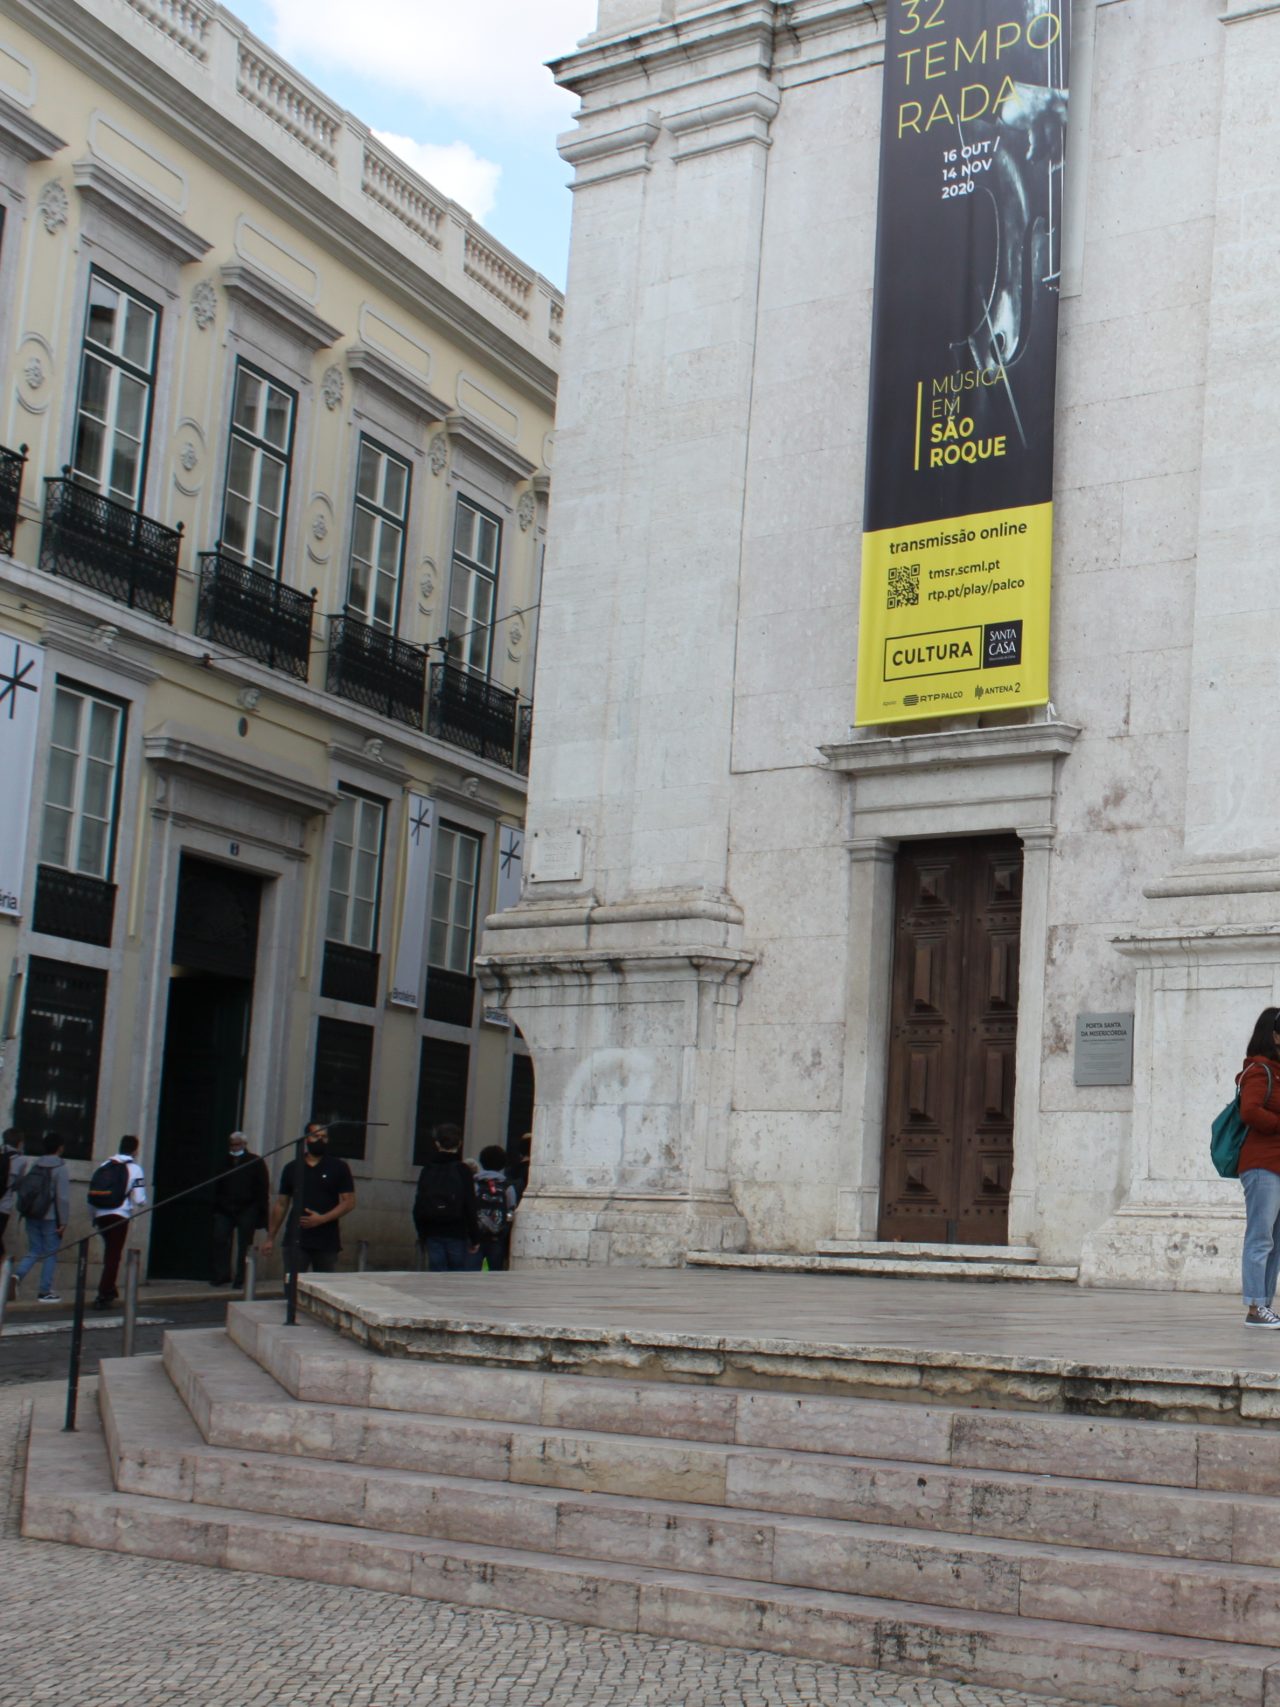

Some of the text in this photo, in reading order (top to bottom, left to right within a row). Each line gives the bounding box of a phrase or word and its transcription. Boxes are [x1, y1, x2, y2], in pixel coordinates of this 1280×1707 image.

[899, 0, 945, 34] 32
[898, 13, 1061, 85] TEMPO
[898, 75, 1021, 139] RADA
[943, 148, 958, 163] 16
[961, 141, 991, 158] OUT
[942, 158, 993, 181] 14 NOV
[941, 180, 975, 199] 2020
[932, 367, 1007, 396] MÚSICA
[931, 396, 960, 418] EM
[930, 415, 974, 443] SÃO
[930, 435, 1007, 468] ROQUE
[889, 521, 1028, 555] transmissão online
[929, 560, 1000, 579] tmsr.scml.pt
[928, 578, 1025, 601] rtp.pt/play/palco
[989, 628, 1017, 642] SANTA
[892, 641, 973, 667] CULTURA
[988, 641, 1016, 656] CASA
[985, 684, 1014, 695] ANTENA
[1014, 682, 1021, 693] 2
